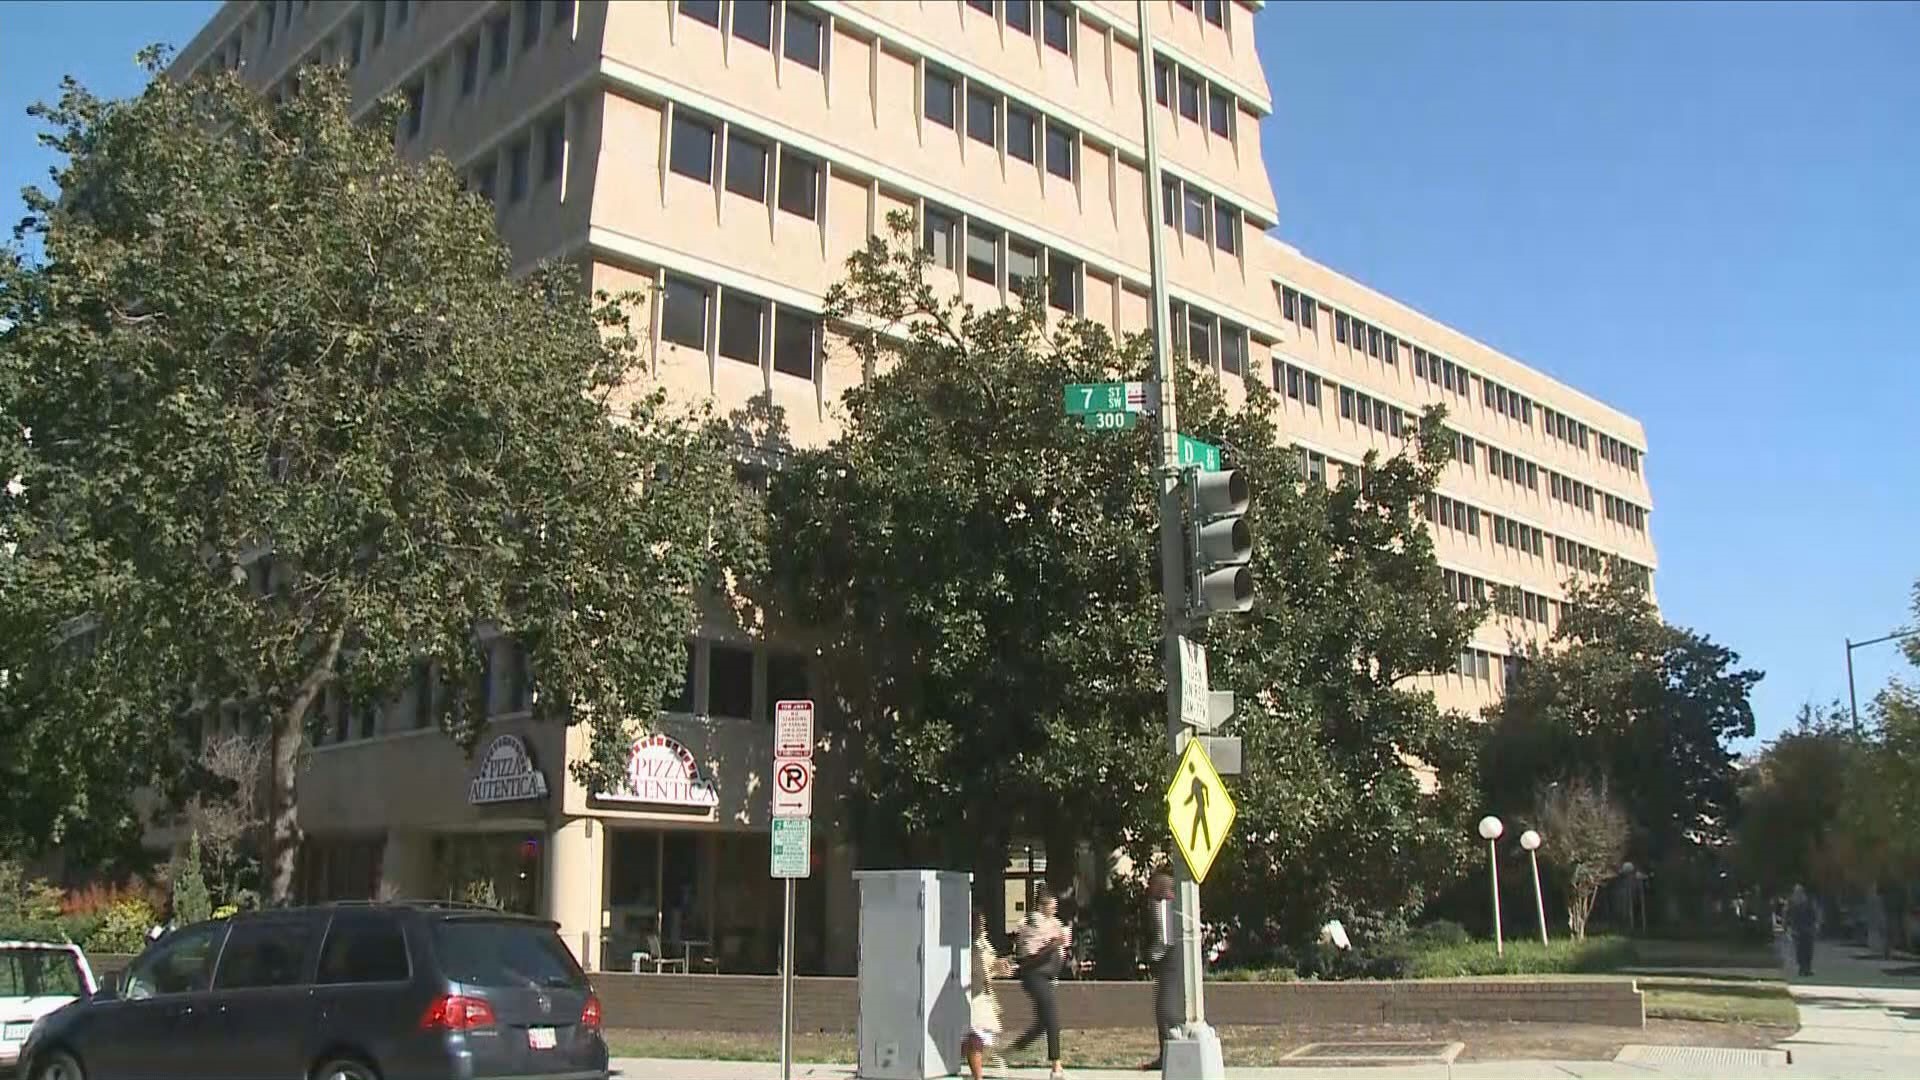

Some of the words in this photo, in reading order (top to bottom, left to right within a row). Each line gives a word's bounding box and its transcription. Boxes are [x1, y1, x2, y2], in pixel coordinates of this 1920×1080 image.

[1081, 389, 1093, 409] 7
[1108, 388, 1120, 397] ST
[1108, 398, 1121, 408] SW
[1096, 413, 1125, 428] 300
[1184, 440, 1194, 464] D
[488, 756, 522, 778] PIZZA
[635, 758, 689, 778] PIZZA
[470, 775, 537, 800] AUTENTICA
[632, 779, 716, 802] TENTICA
